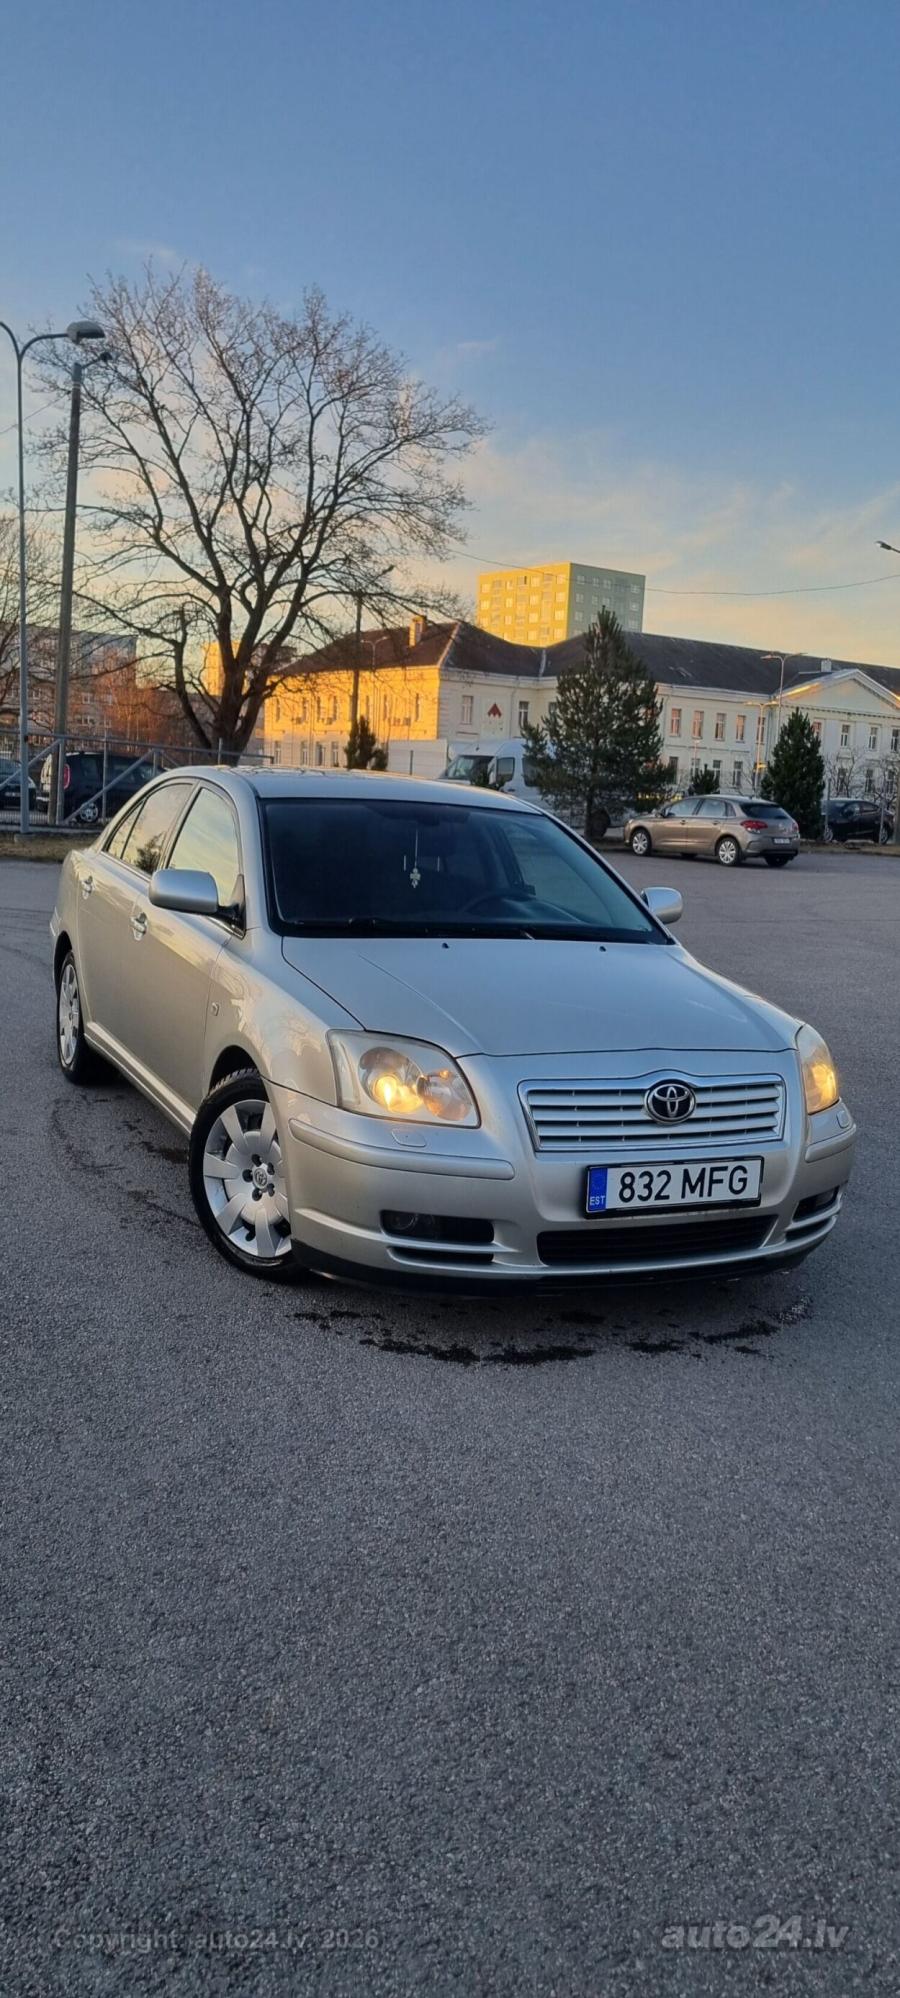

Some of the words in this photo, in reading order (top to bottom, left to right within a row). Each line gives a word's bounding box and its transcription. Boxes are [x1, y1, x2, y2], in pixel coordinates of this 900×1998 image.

[618, 1170, 672, 1203] 832
[680, 1165, 748, 1199] MFG
[589, 1195, 606, 1206] EST
